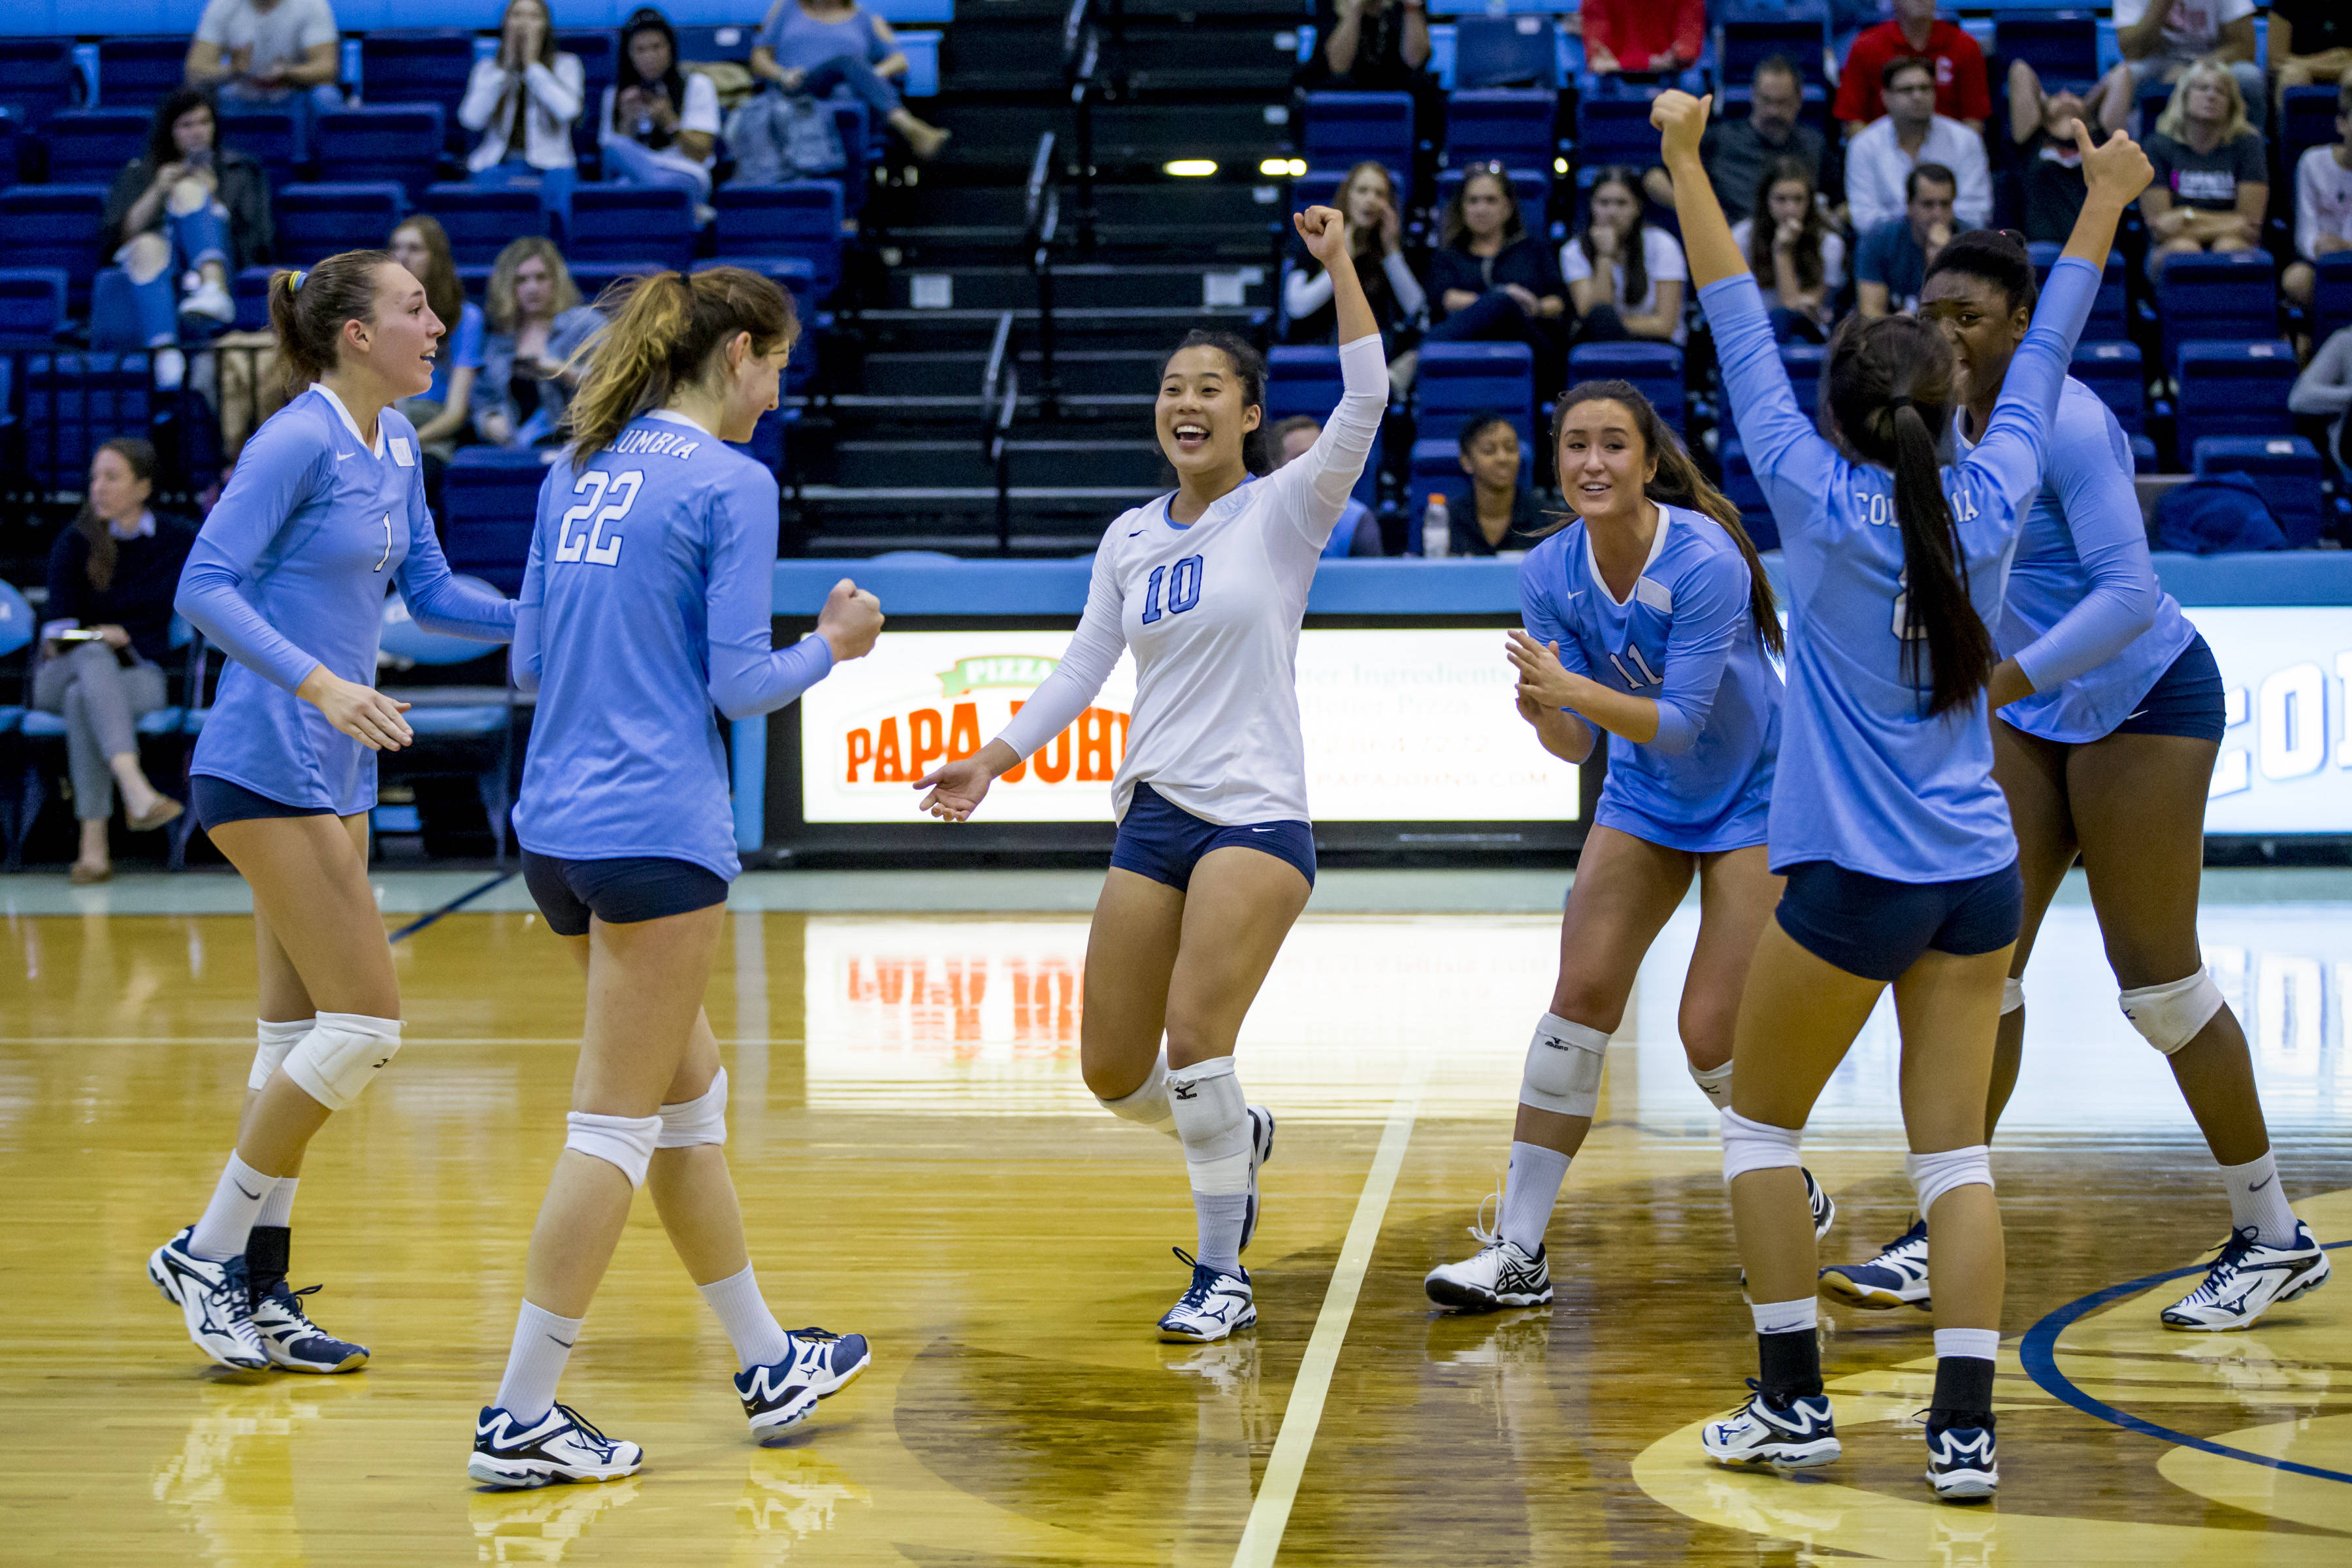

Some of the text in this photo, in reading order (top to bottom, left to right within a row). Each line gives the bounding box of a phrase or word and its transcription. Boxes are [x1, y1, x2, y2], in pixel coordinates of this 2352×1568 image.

[602, 429, 700, 460] LUMBIA
[373, 511, 392, 573] 1
[555, 469, 645, 567] 22
[1142, 554, 1203, 625] 10
[1609, 642, 1664, 691] 11
[847, 702, 981, 783] PAPA
